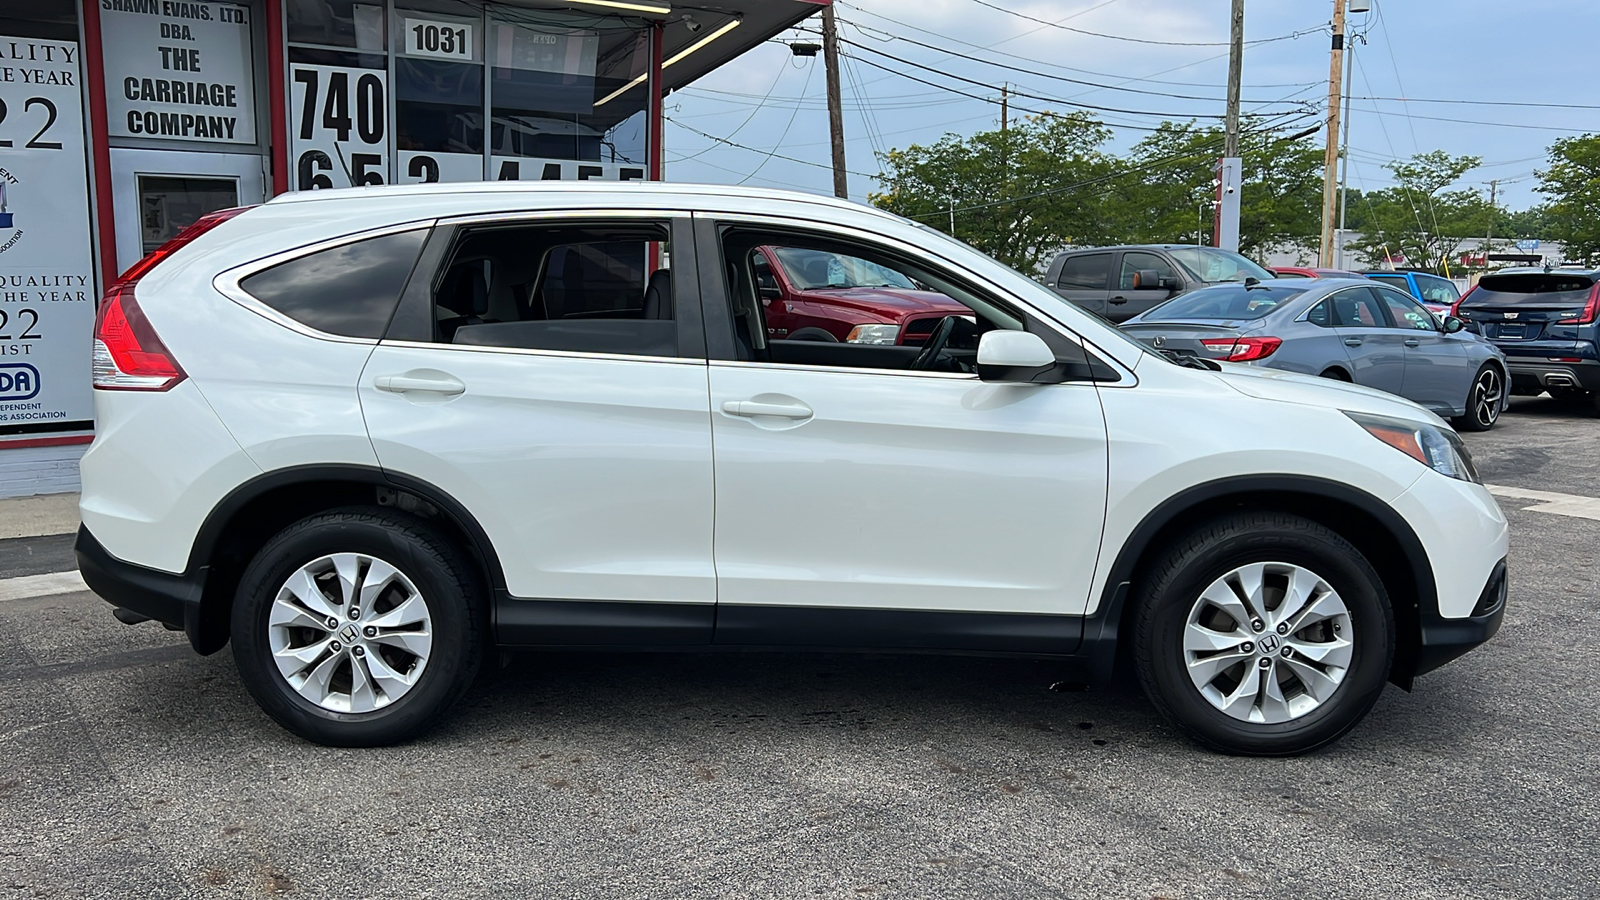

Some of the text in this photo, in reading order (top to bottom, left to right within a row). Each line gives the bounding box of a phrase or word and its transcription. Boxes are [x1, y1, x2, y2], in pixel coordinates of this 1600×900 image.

[102, 0, 247, 25] SHAWN EVANS. LTD.
[160, 22, 195, 41] DBA.
[413, 24, 466, 55] 1031
[158, 46, 200, 72] THE
[0, 67, 75, 87] E YEAR
[124, 77, 237, 107] CARRIAGE
[294, 69, 384, 145] 740
[127, 110, 236, 139] COMPANY
[0, 291, 87, 302] HE YEAR
[1, 344, 33, 356] IST
[10, 411, 67, 421] ASSOCIATION
